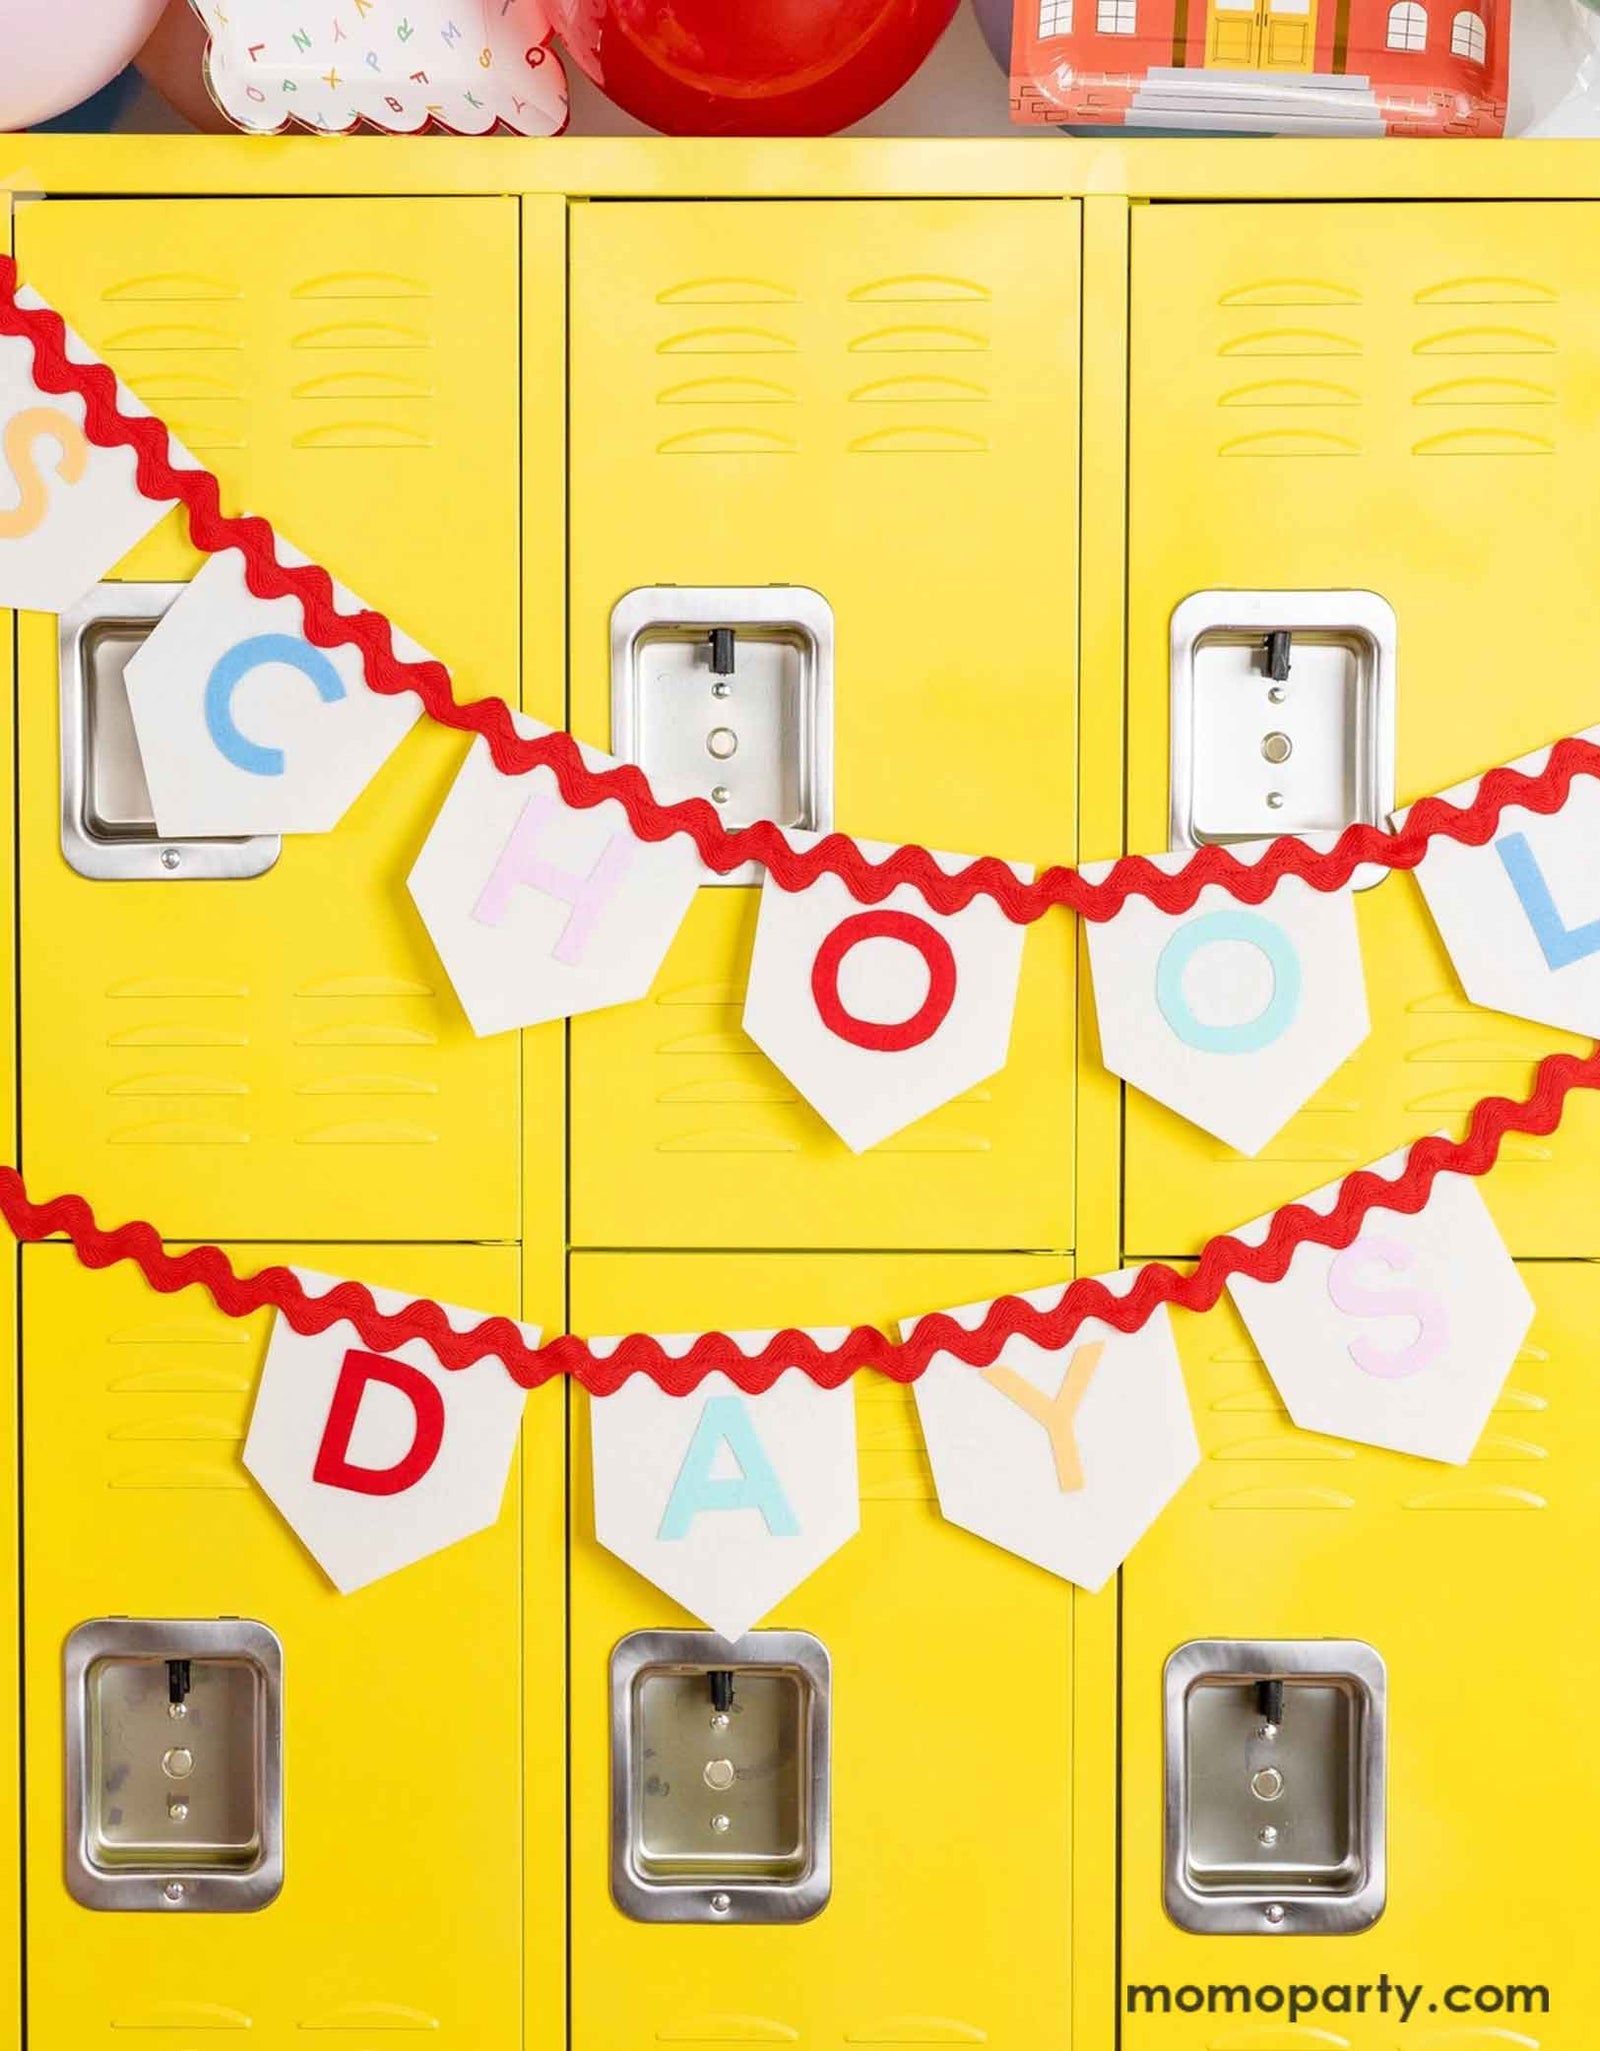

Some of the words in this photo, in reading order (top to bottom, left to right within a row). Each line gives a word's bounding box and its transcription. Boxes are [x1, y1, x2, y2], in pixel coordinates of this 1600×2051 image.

[396, 17, 414, 42] R
[525, 46, 545, 69] Q
[384, 96, 404, 112] B
[0, 407, 1600, 1054] SCHOOL
[313, 1236, 1450, 1542] DAYS
